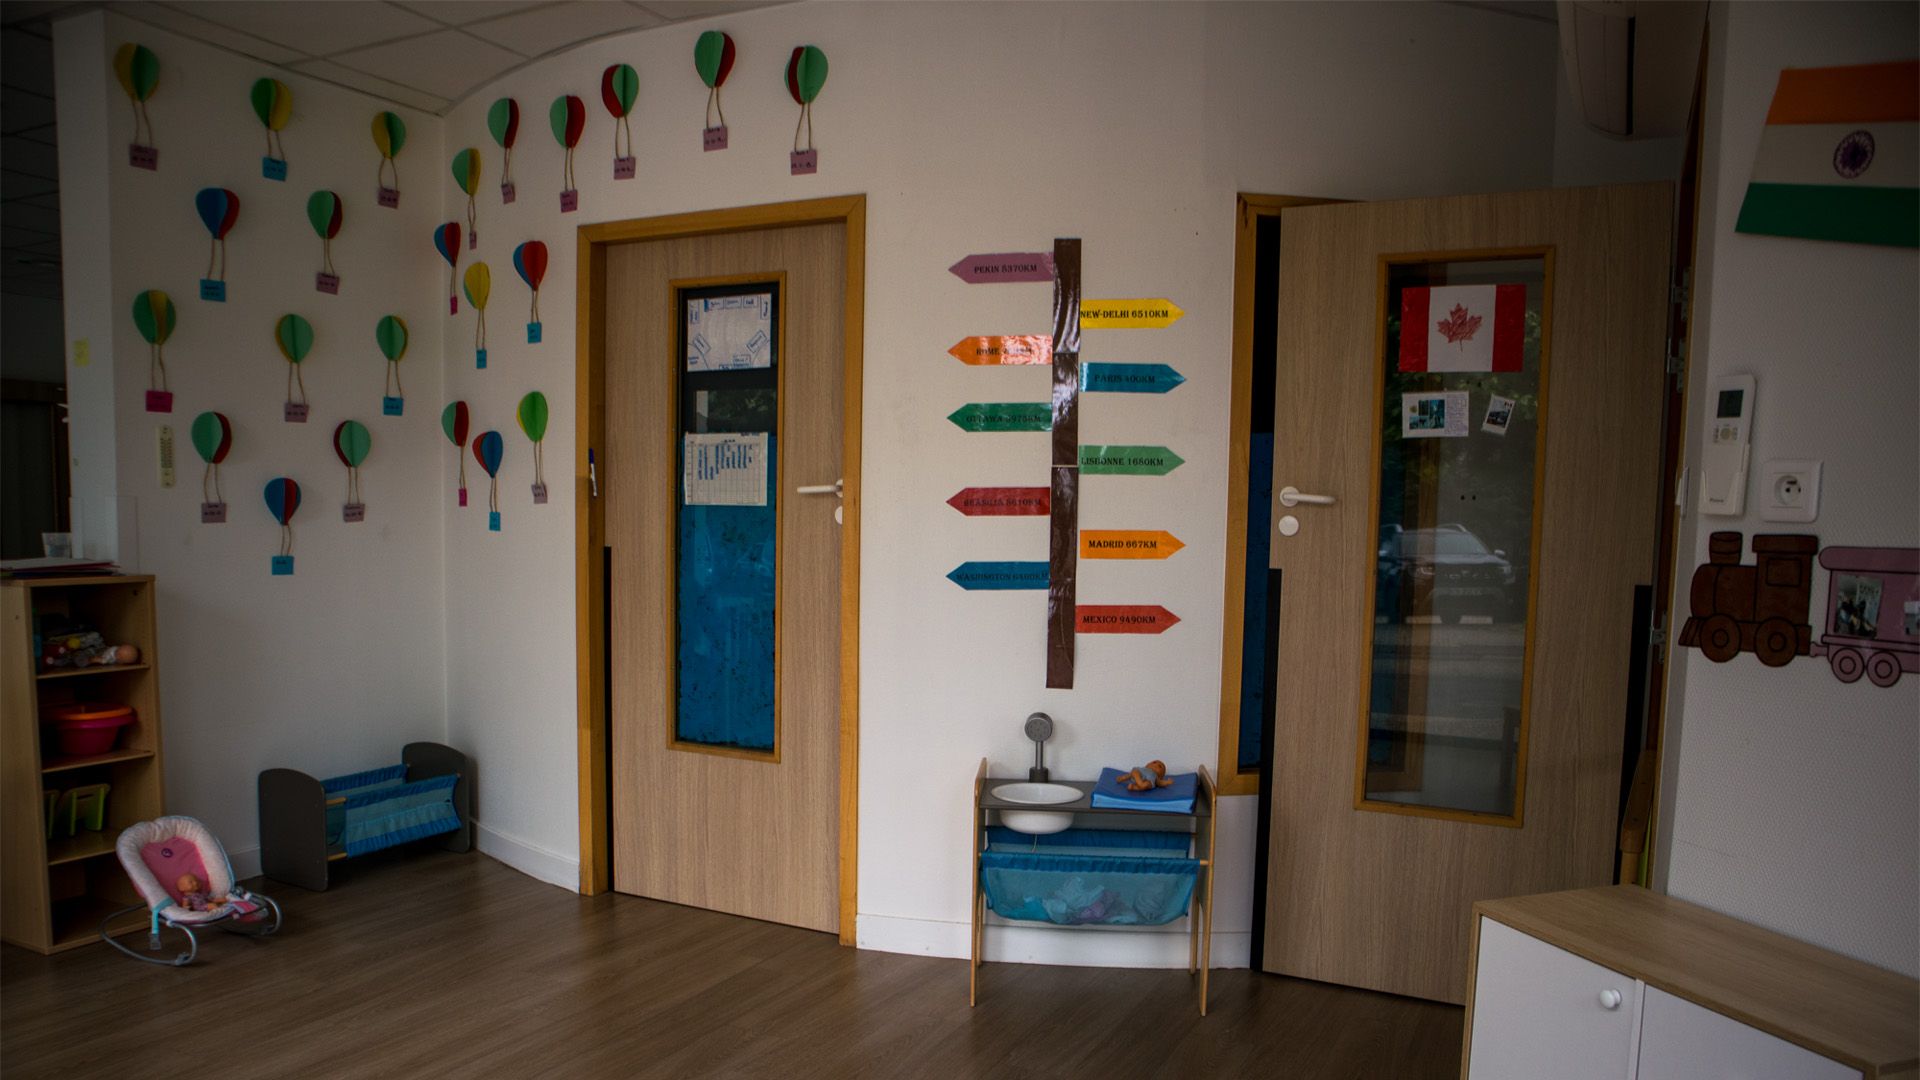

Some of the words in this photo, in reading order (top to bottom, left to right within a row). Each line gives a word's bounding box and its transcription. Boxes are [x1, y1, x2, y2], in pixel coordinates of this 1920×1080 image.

[974, 265, 999, 274] PEKIN
[1080, 310, 1129, 319] NEW-DELHI
[1131, 310, 1168, 318] 6510KM
[1094, 374, 1122, 384] PARIS
[1088, 540, 1124, 548] MADRID
[1126, 540, 1157, 549] 667KM
[1082, 615, 1118, 624] MEXICO
[1119, 615, 1156, 624] 9490KM
